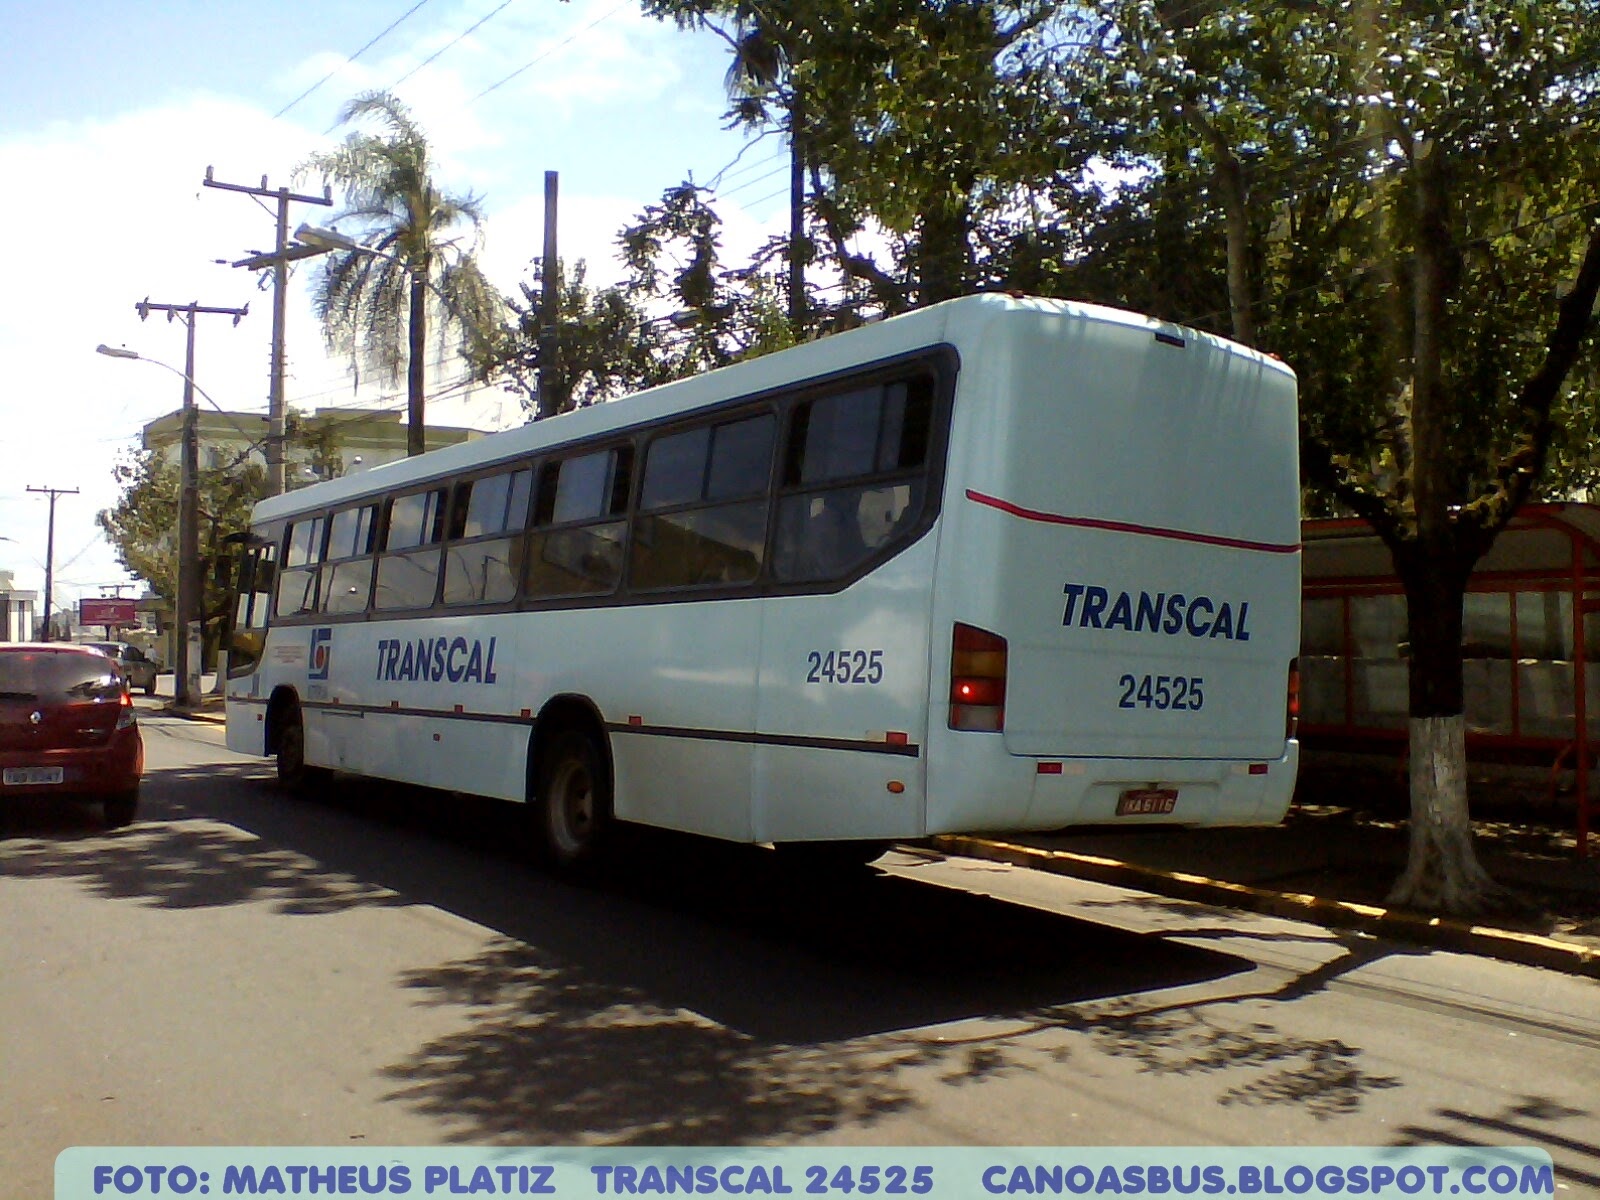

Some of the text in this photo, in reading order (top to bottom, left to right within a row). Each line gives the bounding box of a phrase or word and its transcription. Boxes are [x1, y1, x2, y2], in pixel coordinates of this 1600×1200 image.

[1063, 584, 1249, 640] TRANSCAL
[377, 637, 496, 684] TRANSCAL
[807, 651, 882, 684] 24525
[1119, 675, 1203, 710] 24525
